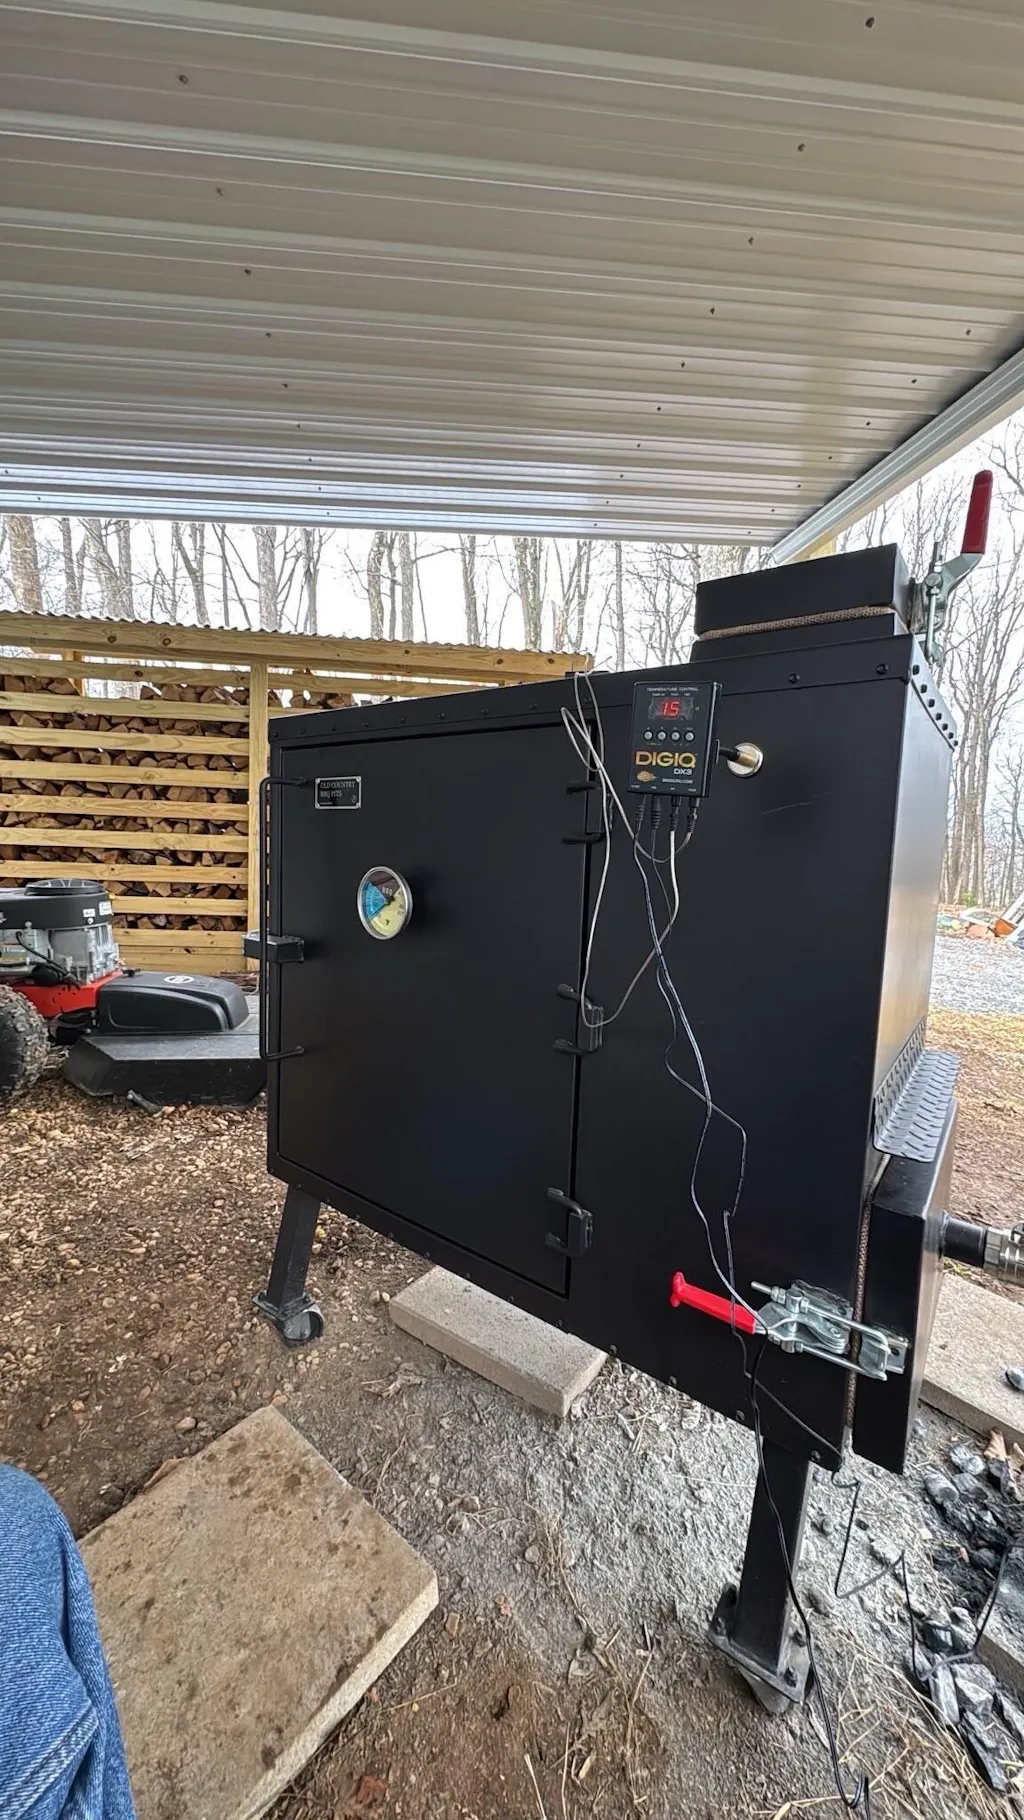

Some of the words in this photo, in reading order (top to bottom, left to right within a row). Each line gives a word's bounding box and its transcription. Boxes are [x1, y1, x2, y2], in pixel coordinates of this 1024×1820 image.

[663, 701, 680, 717] 15
[635, 751, 696, 768] DIGIQ
[331, 780, 355, 788] COUNTRY
